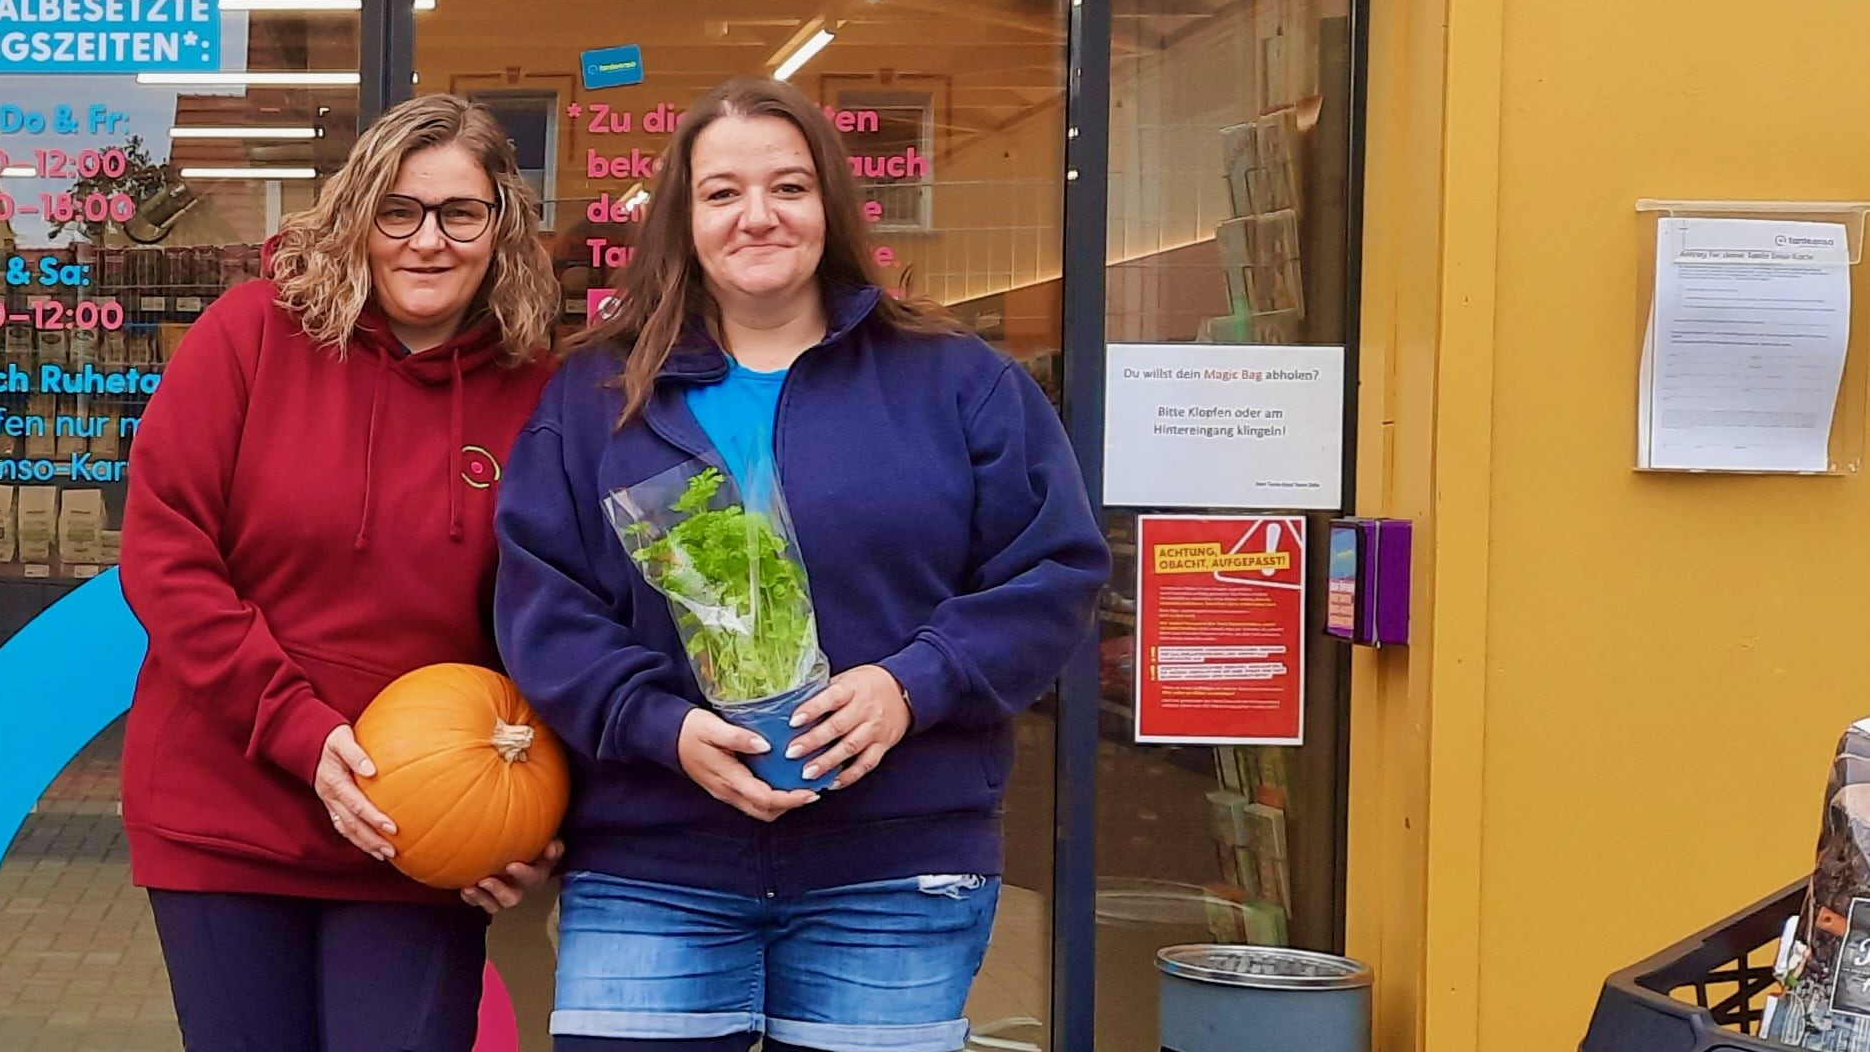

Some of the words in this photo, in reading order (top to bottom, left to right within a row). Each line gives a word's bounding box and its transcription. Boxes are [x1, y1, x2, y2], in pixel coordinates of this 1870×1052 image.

[53, 104, 78, 134] &
[87, 104, 129, 134] Fr:
[5, 255, 30, 286] &
[39, 255, 91, 286] Sa:
[41, 363, 163, 394] Ruheta
[1124, 369, 1140, 380] Du
[1143, 369, 1172, 380] willst
[1176, 370, 1201, 380] dein
[1204, 370, 1238, 383] Magic
[1241, 370, 1262, 382] Bag
[1265, 370, 1319, 381] abholen?
[1158, 407, 1185, 417] Bitte
[1188, 407, 1231, 419] Klopfen
[1235, 408, 1261, 418] oder
[1265, 410, 1283, 418] am
[56, 416, 109, 438] nur
[1154, 425, 1234, 437] Hintereingang
[1237, 426, 1286, 438] klingeln!
[1159, 548, 1218, 558] ACHTUNG,
[1159, 559, 1209, 569] OBACHT,
[1211, 556, 1286, 568] AUFGEPASST!
